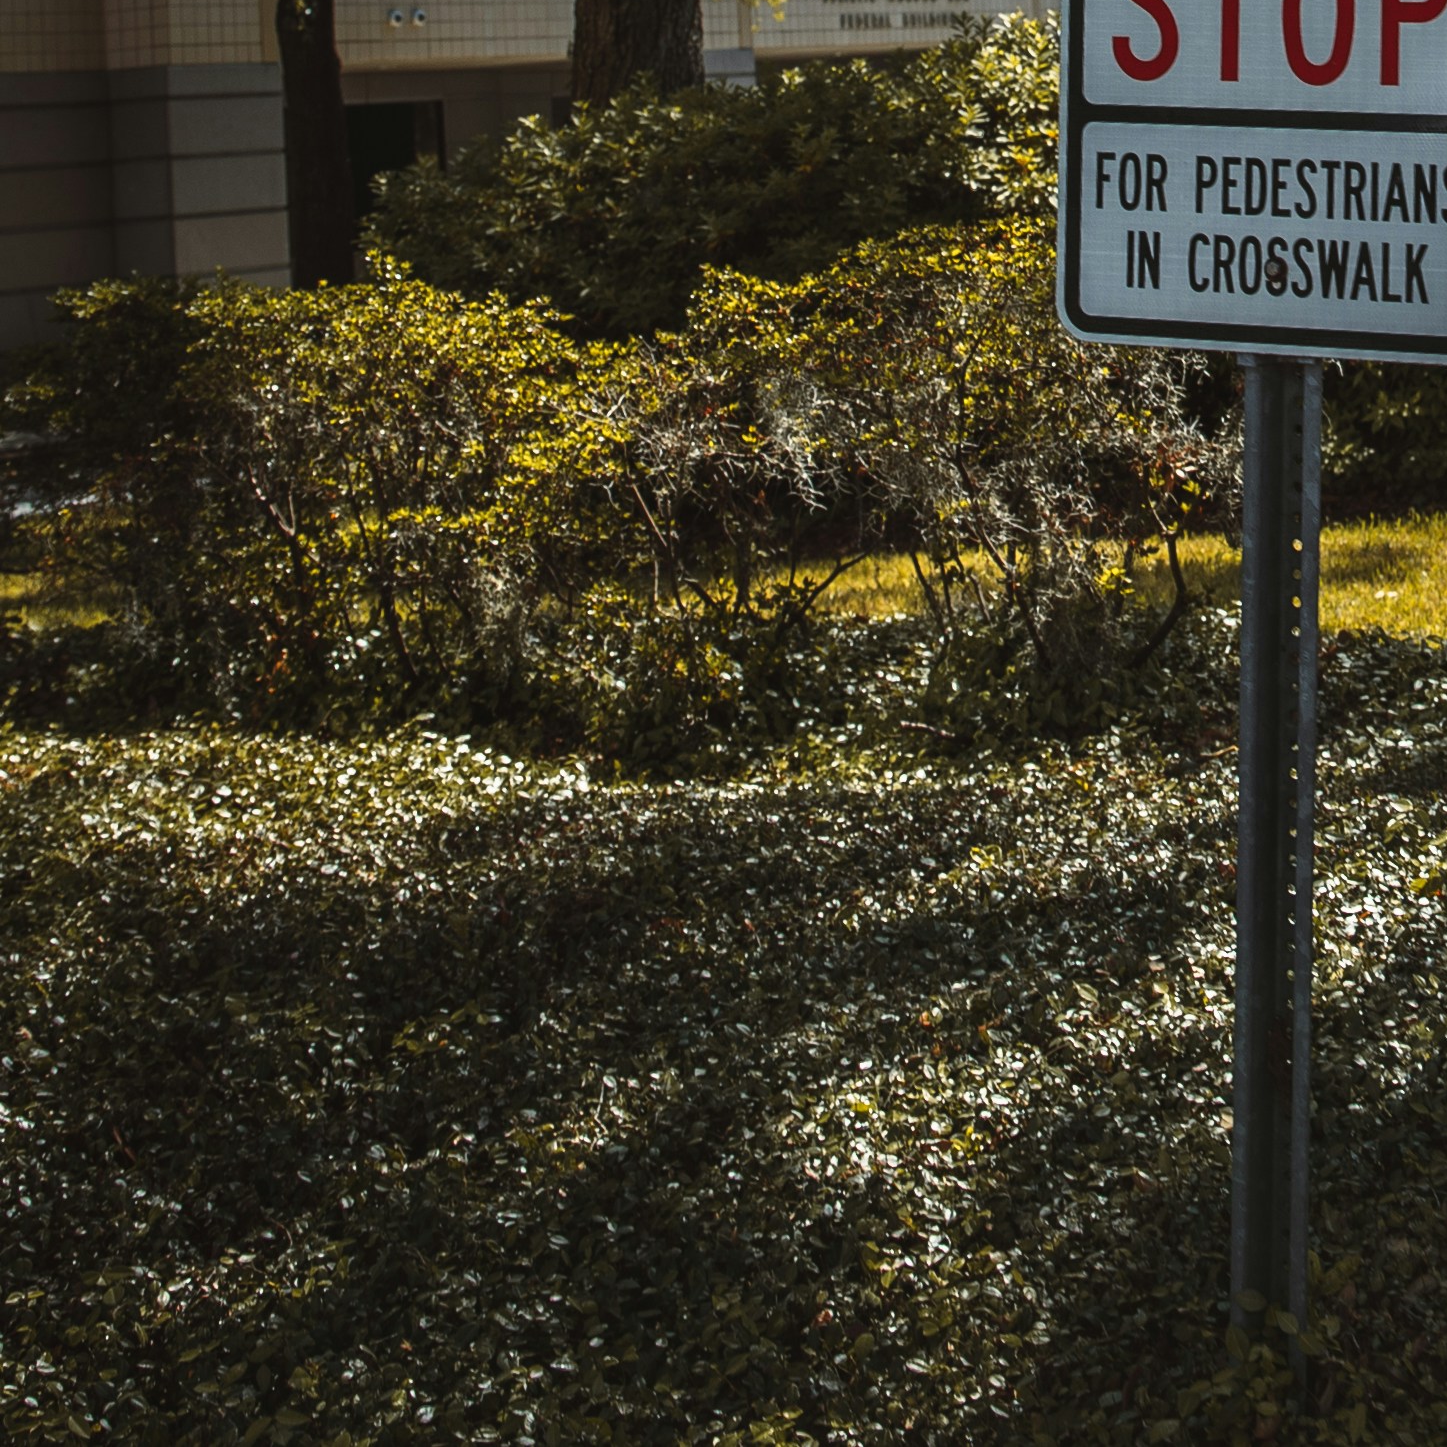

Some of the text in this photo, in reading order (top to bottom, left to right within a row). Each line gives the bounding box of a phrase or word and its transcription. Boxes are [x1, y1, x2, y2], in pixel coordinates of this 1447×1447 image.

[1095, 151, 1168, 213] FOR
[1126, 229, 1430, 304] IN CROSSWALK
